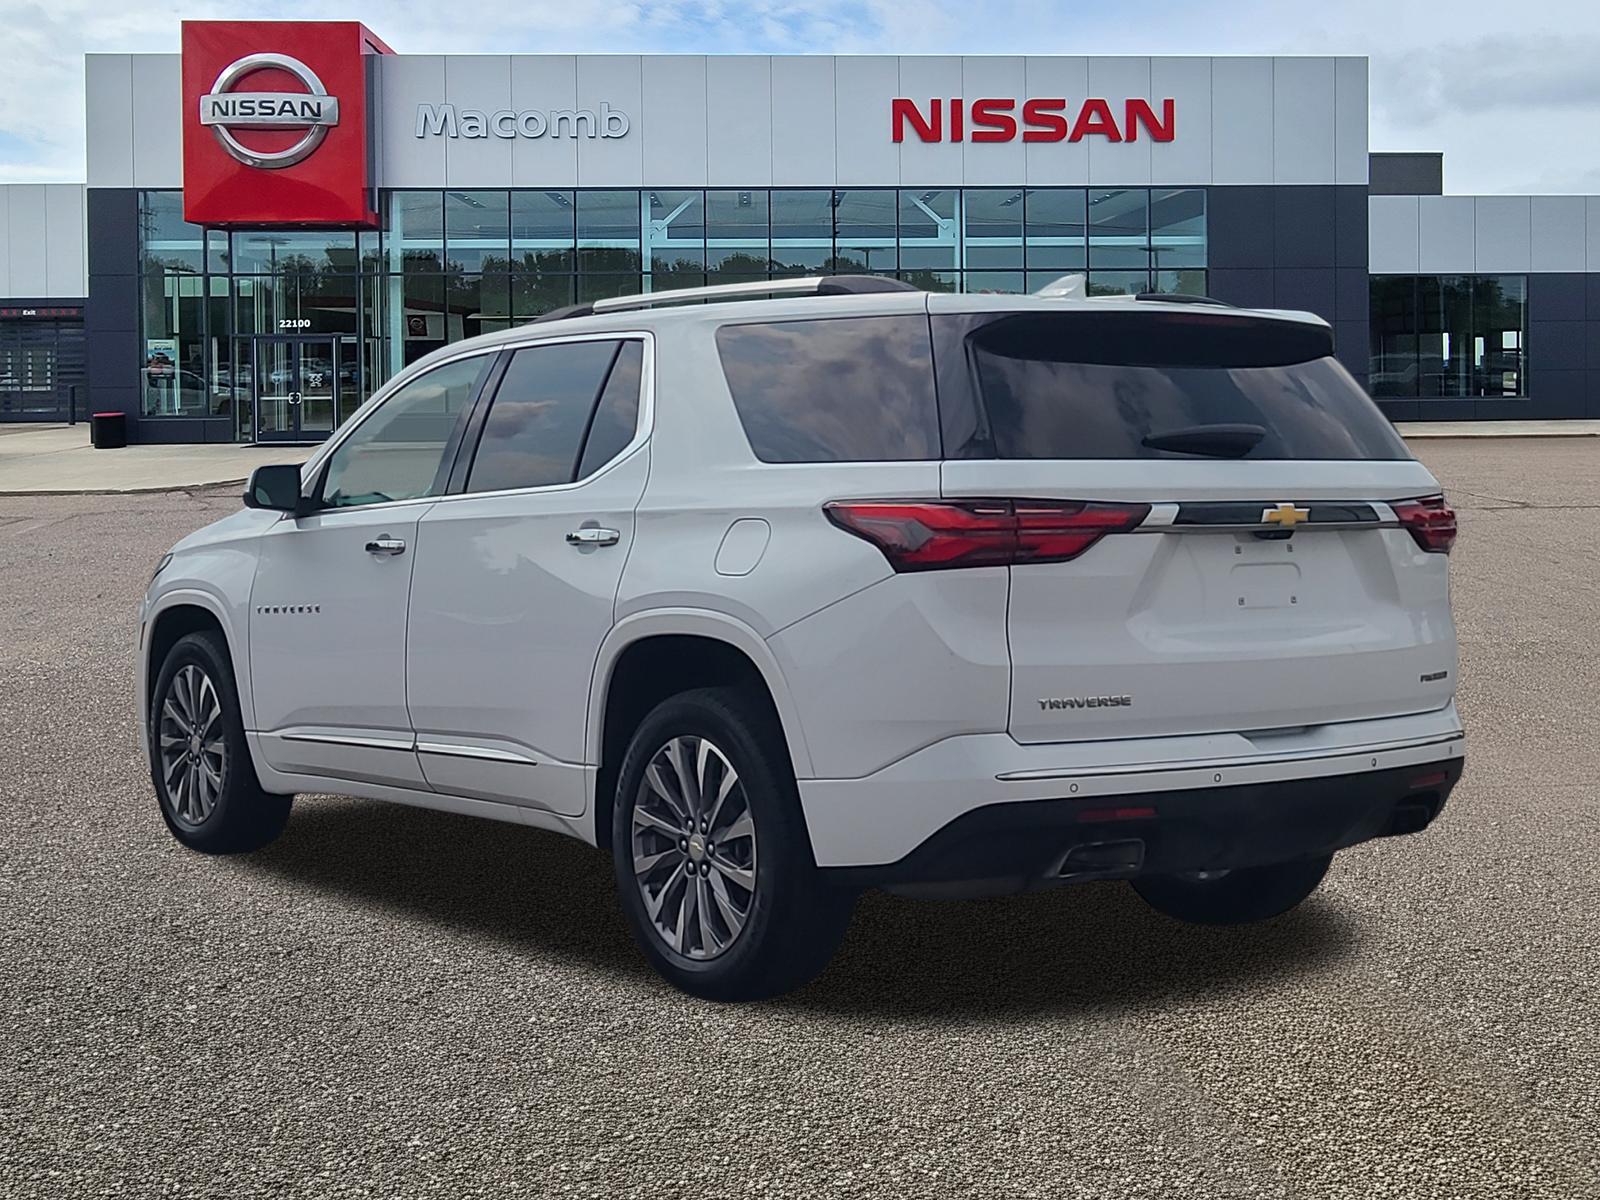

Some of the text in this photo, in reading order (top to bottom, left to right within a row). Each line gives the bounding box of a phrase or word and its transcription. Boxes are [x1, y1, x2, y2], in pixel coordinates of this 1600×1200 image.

[211, 99, 322, 118] NISSAN
[415, 102, 630, 139] Macomb
[892, 98, 1175, 143] NISSAN
[279, 319, 311, 328] 22100
[256, 603, 321, 615] TRAVERSE
[1038, 695, 1132, 710] TRAVERSE
